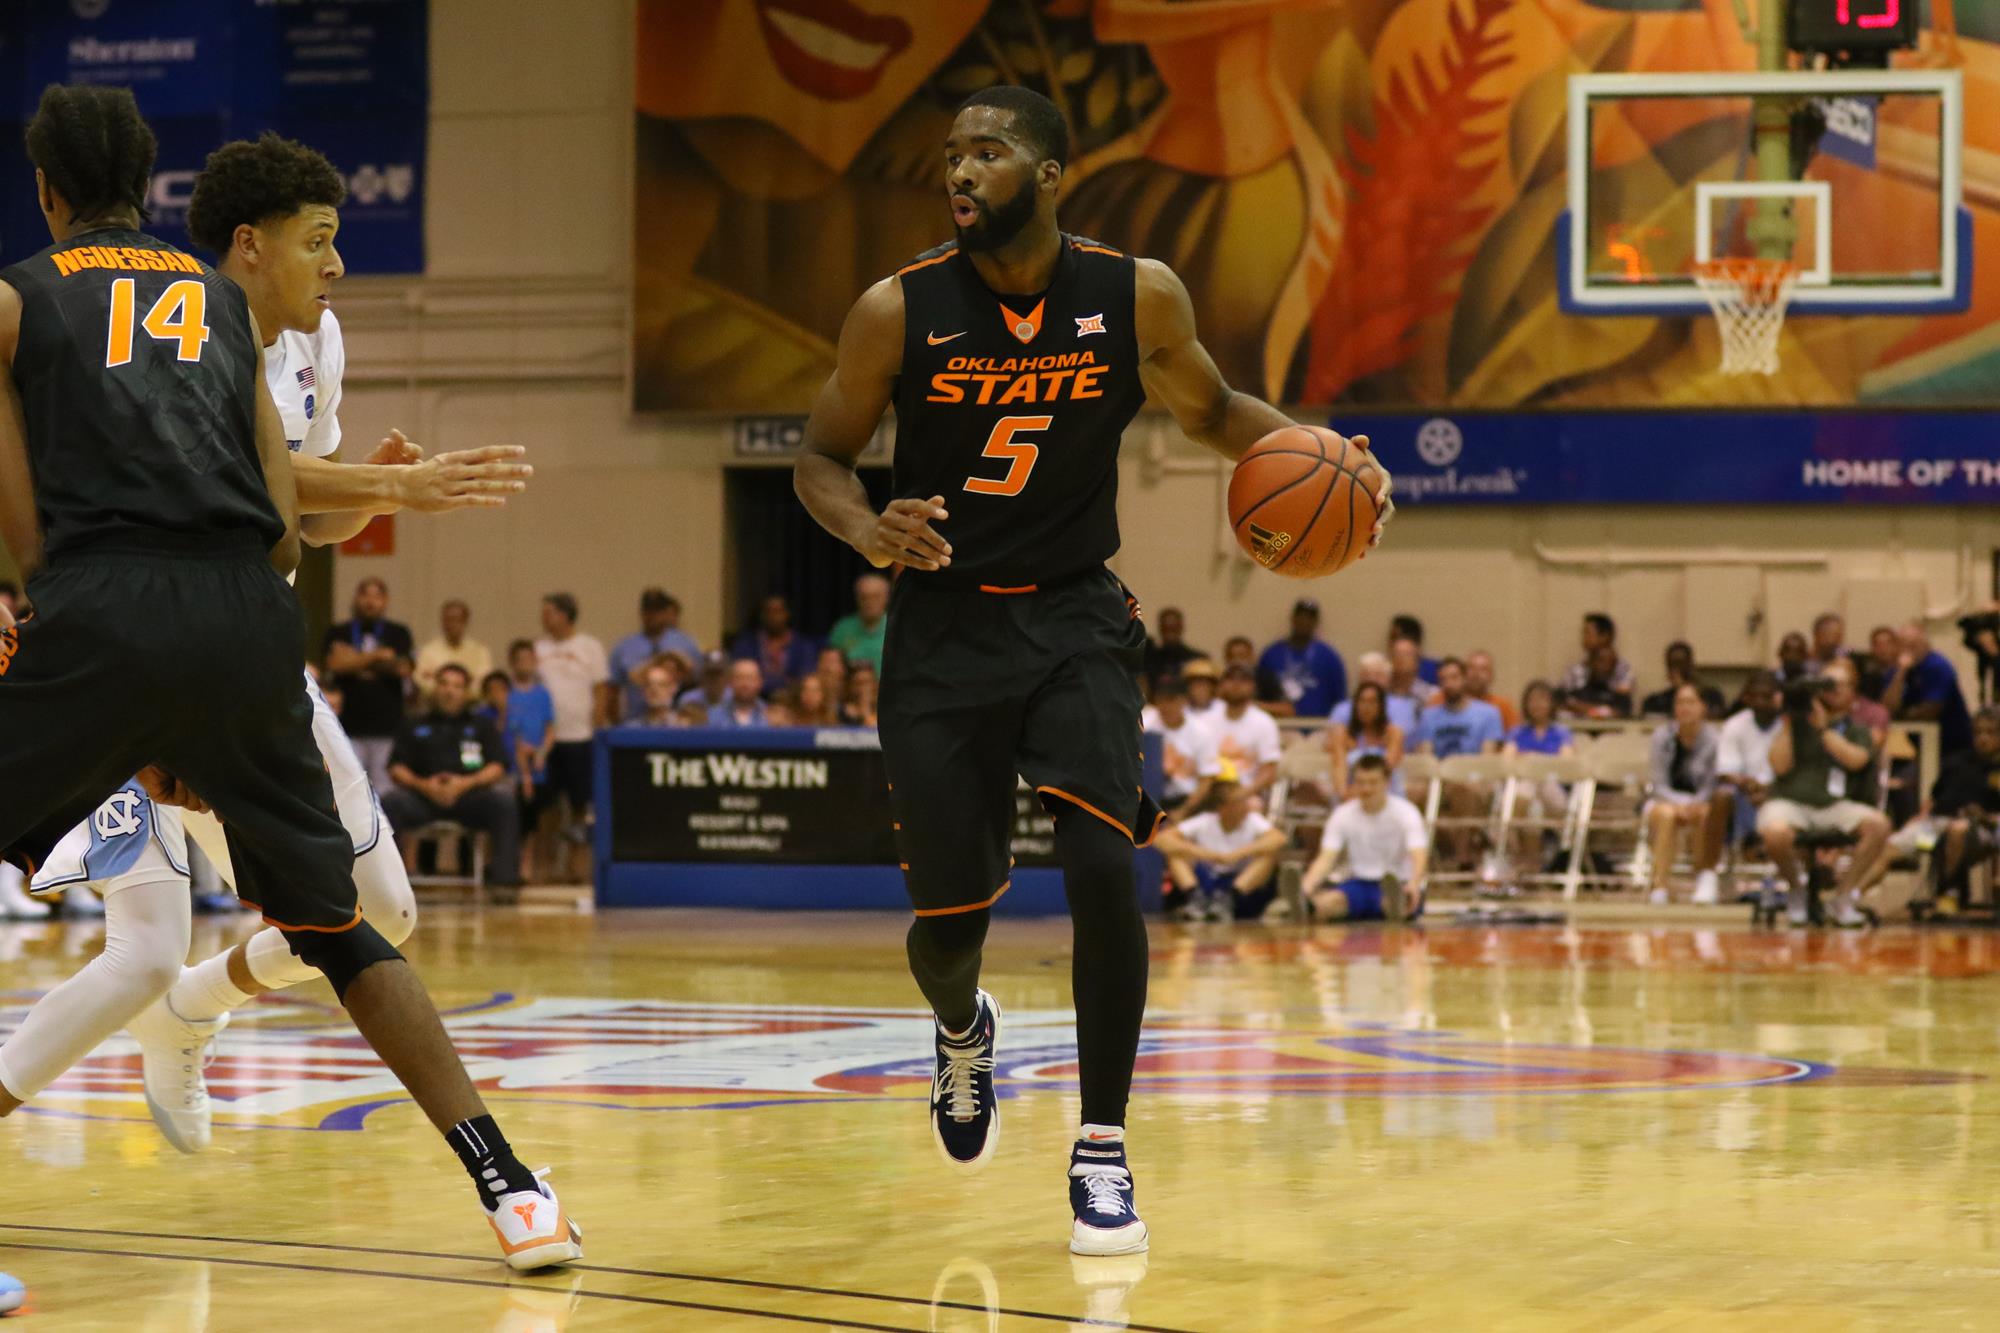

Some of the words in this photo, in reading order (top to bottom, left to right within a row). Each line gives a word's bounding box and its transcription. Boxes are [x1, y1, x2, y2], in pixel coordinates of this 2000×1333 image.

[50, 246, 205, 277] NGUESSAN
[106, 278, 210, 368] 14
[947, 350, 1096, 371] OKLAHOMA
[926, 365, 1110, 405] STATE
[963, 416, 1054, 497] 5
[1803, 460, 1902, 486] HOME
[1908, 460, 1955, 486] OF
[647, 753, 707, 786] THE
[706, 753, 829, 789] WESTIN
